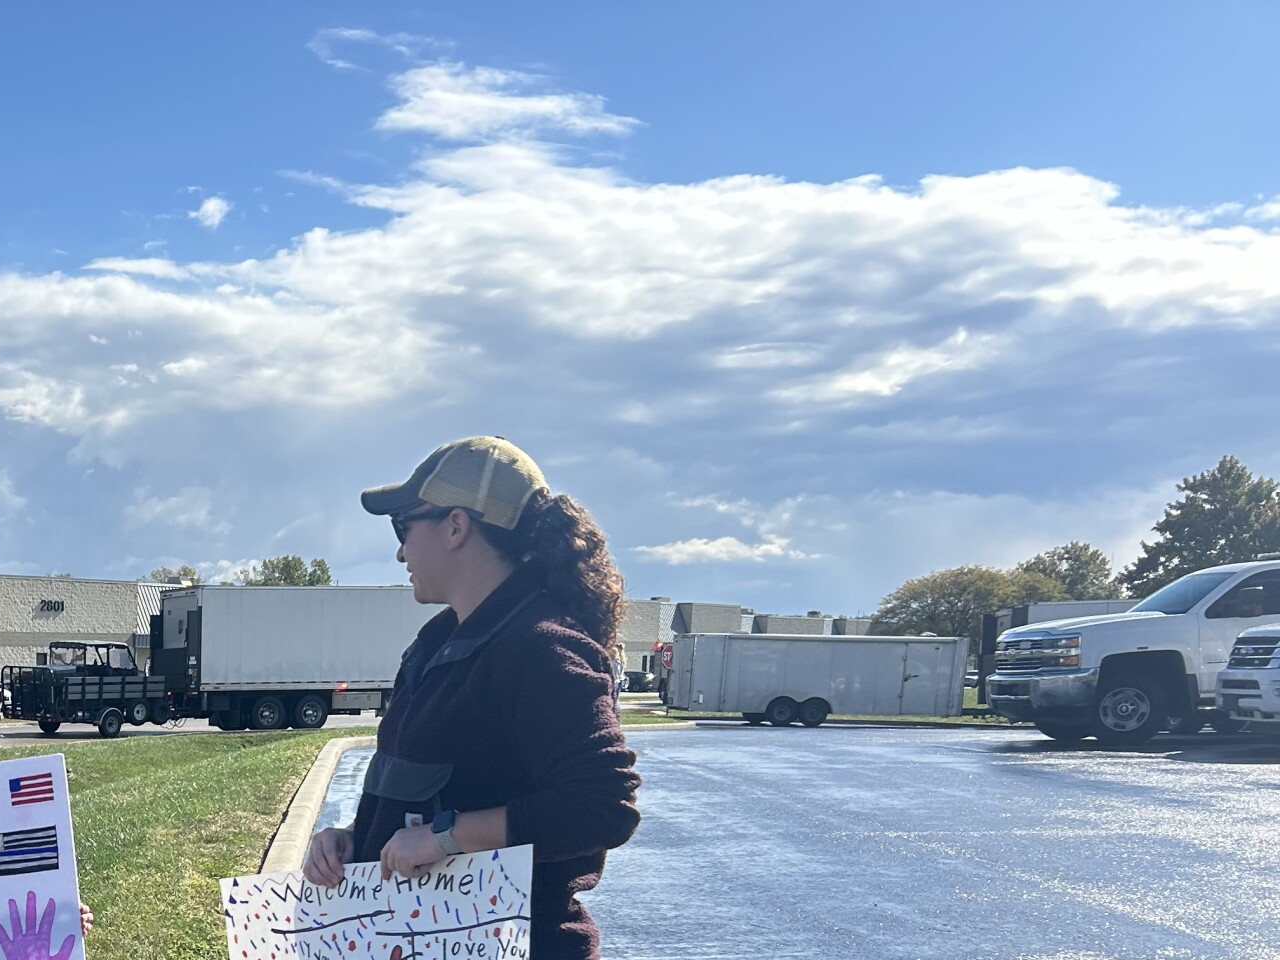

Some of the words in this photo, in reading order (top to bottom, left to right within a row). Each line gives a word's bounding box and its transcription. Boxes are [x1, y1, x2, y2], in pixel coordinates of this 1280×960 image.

[40, 599, 65, 612] 2801
[663, 651, 672, 662] ST
[270, 876, 383, 907] Welcome
[442, 937, 487, 960] love
